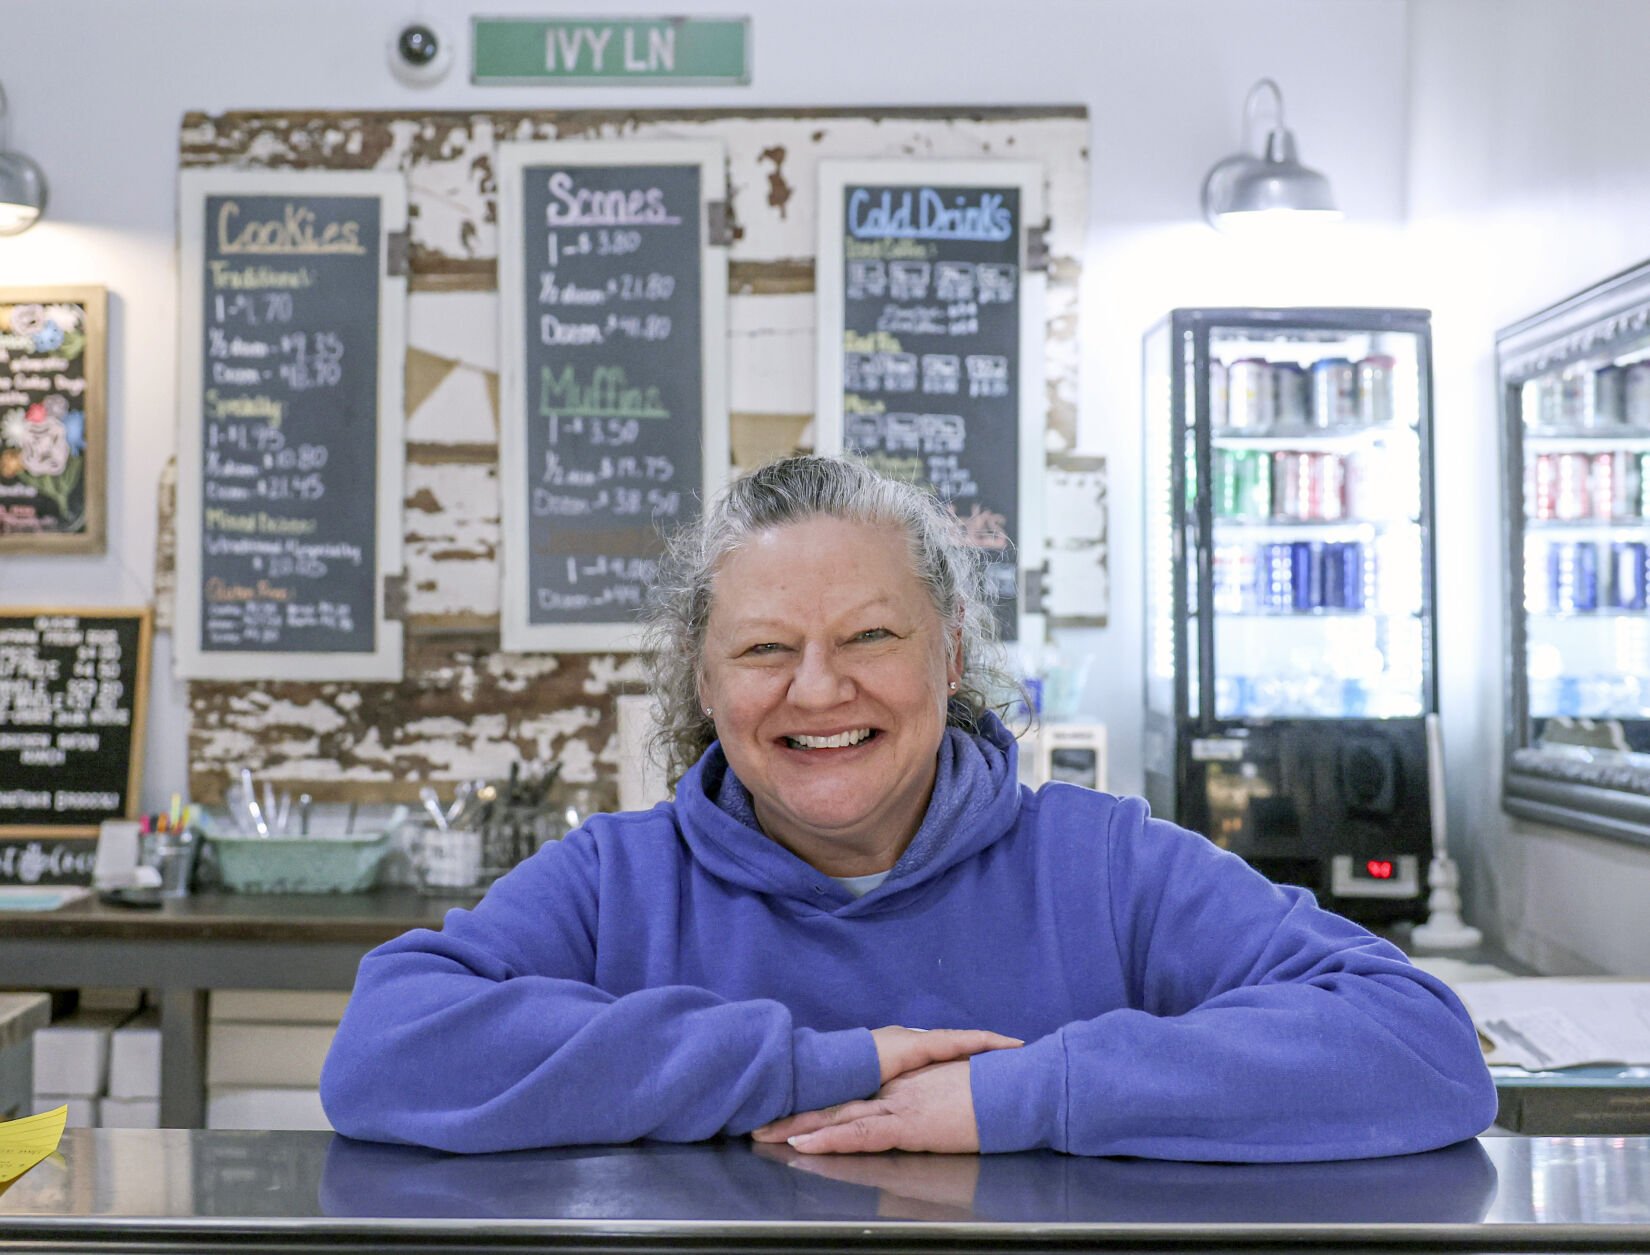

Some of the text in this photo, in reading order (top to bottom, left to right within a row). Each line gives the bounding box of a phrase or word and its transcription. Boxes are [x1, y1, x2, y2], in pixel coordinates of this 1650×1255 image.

[546, 27, 675, 72] IVY LN
[547, 171, 667, 224] Scones
[850, 187, 913, 238] Cold
